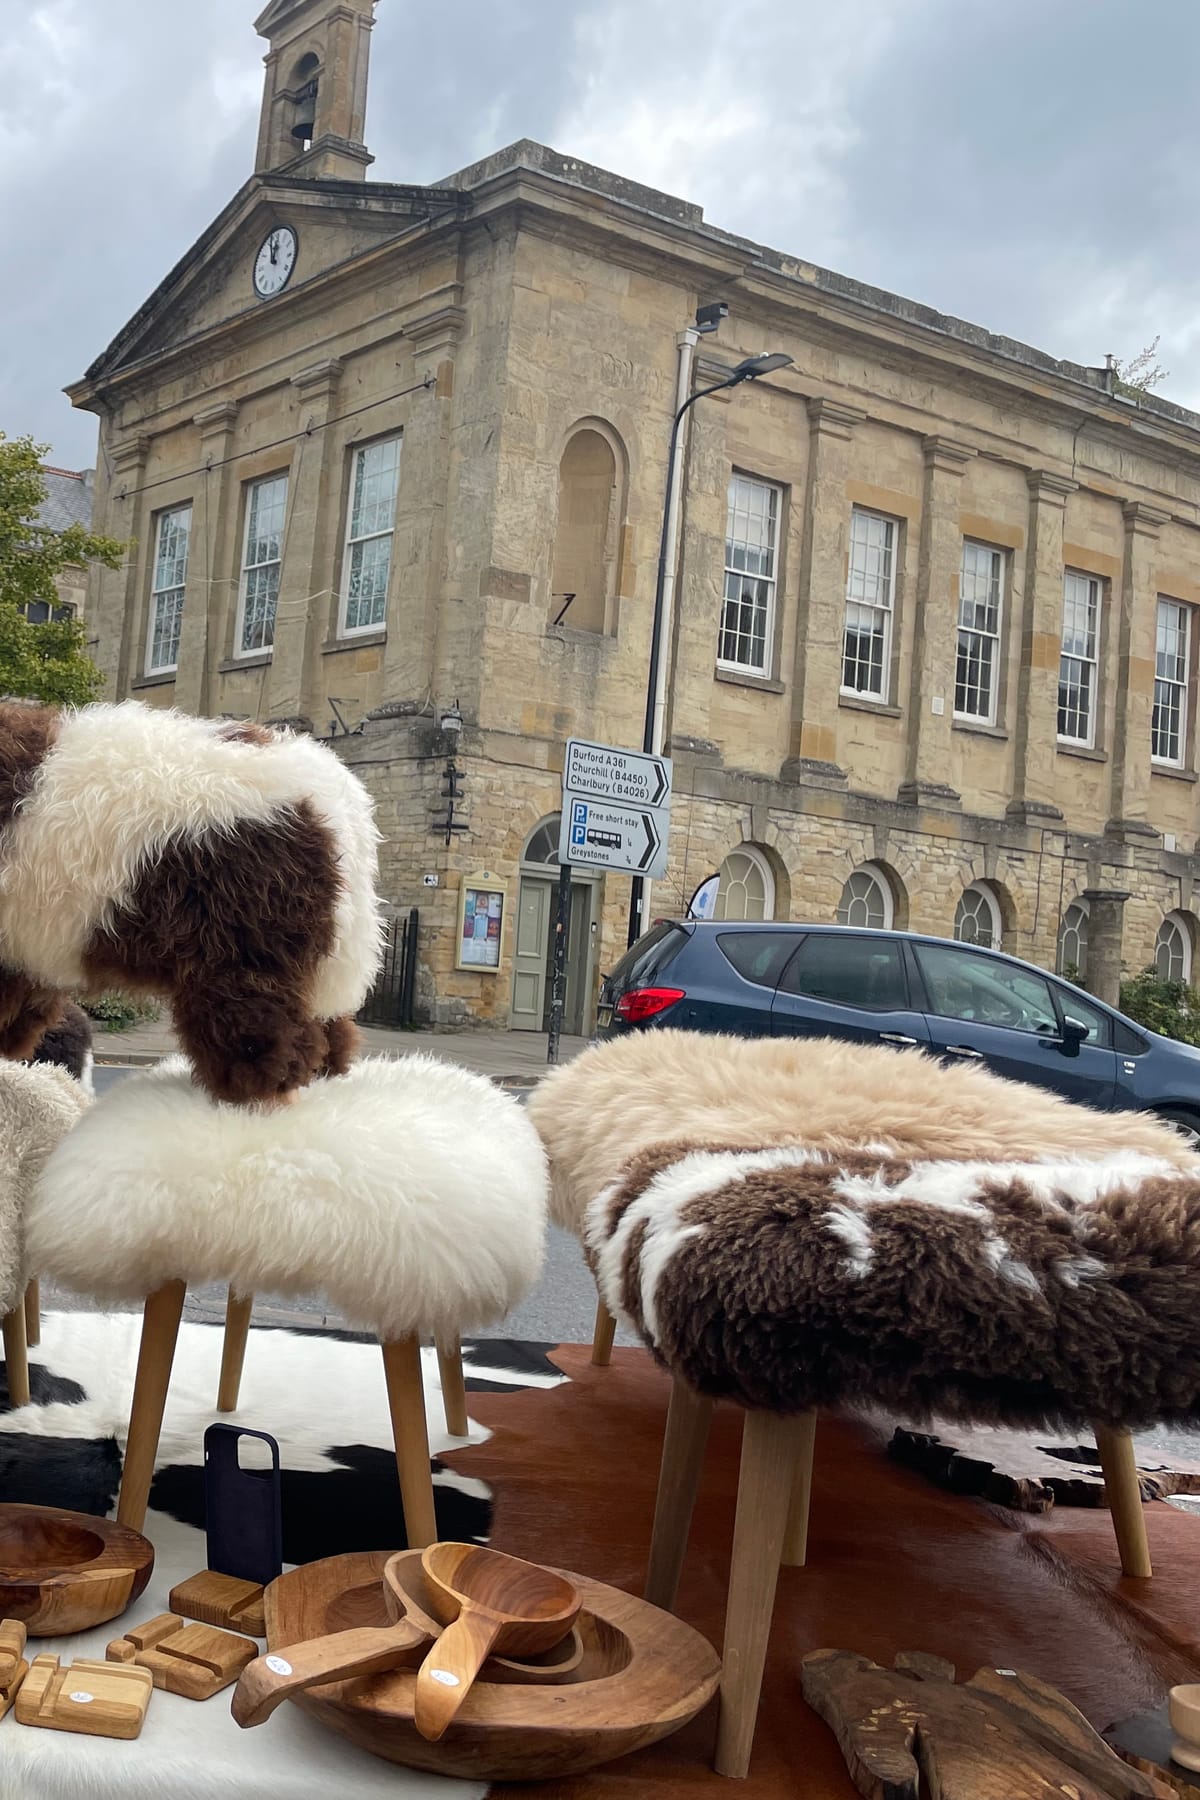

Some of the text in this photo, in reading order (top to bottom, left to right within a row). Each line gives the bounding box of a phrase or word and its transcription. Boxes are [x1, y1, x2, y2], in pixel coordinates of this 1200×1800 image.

[573, 748, 627, 769] Burford A361
[572, 762, 648, 787] Churchill (B4450)
[570, 775, 650, 800] Charlbury (B4026)
[589, 810, 604, 821] Free
[605, 813, 623, 825] short
[625, 818, 639, 829] stay
[571, 846, 610, 861] Greystones
